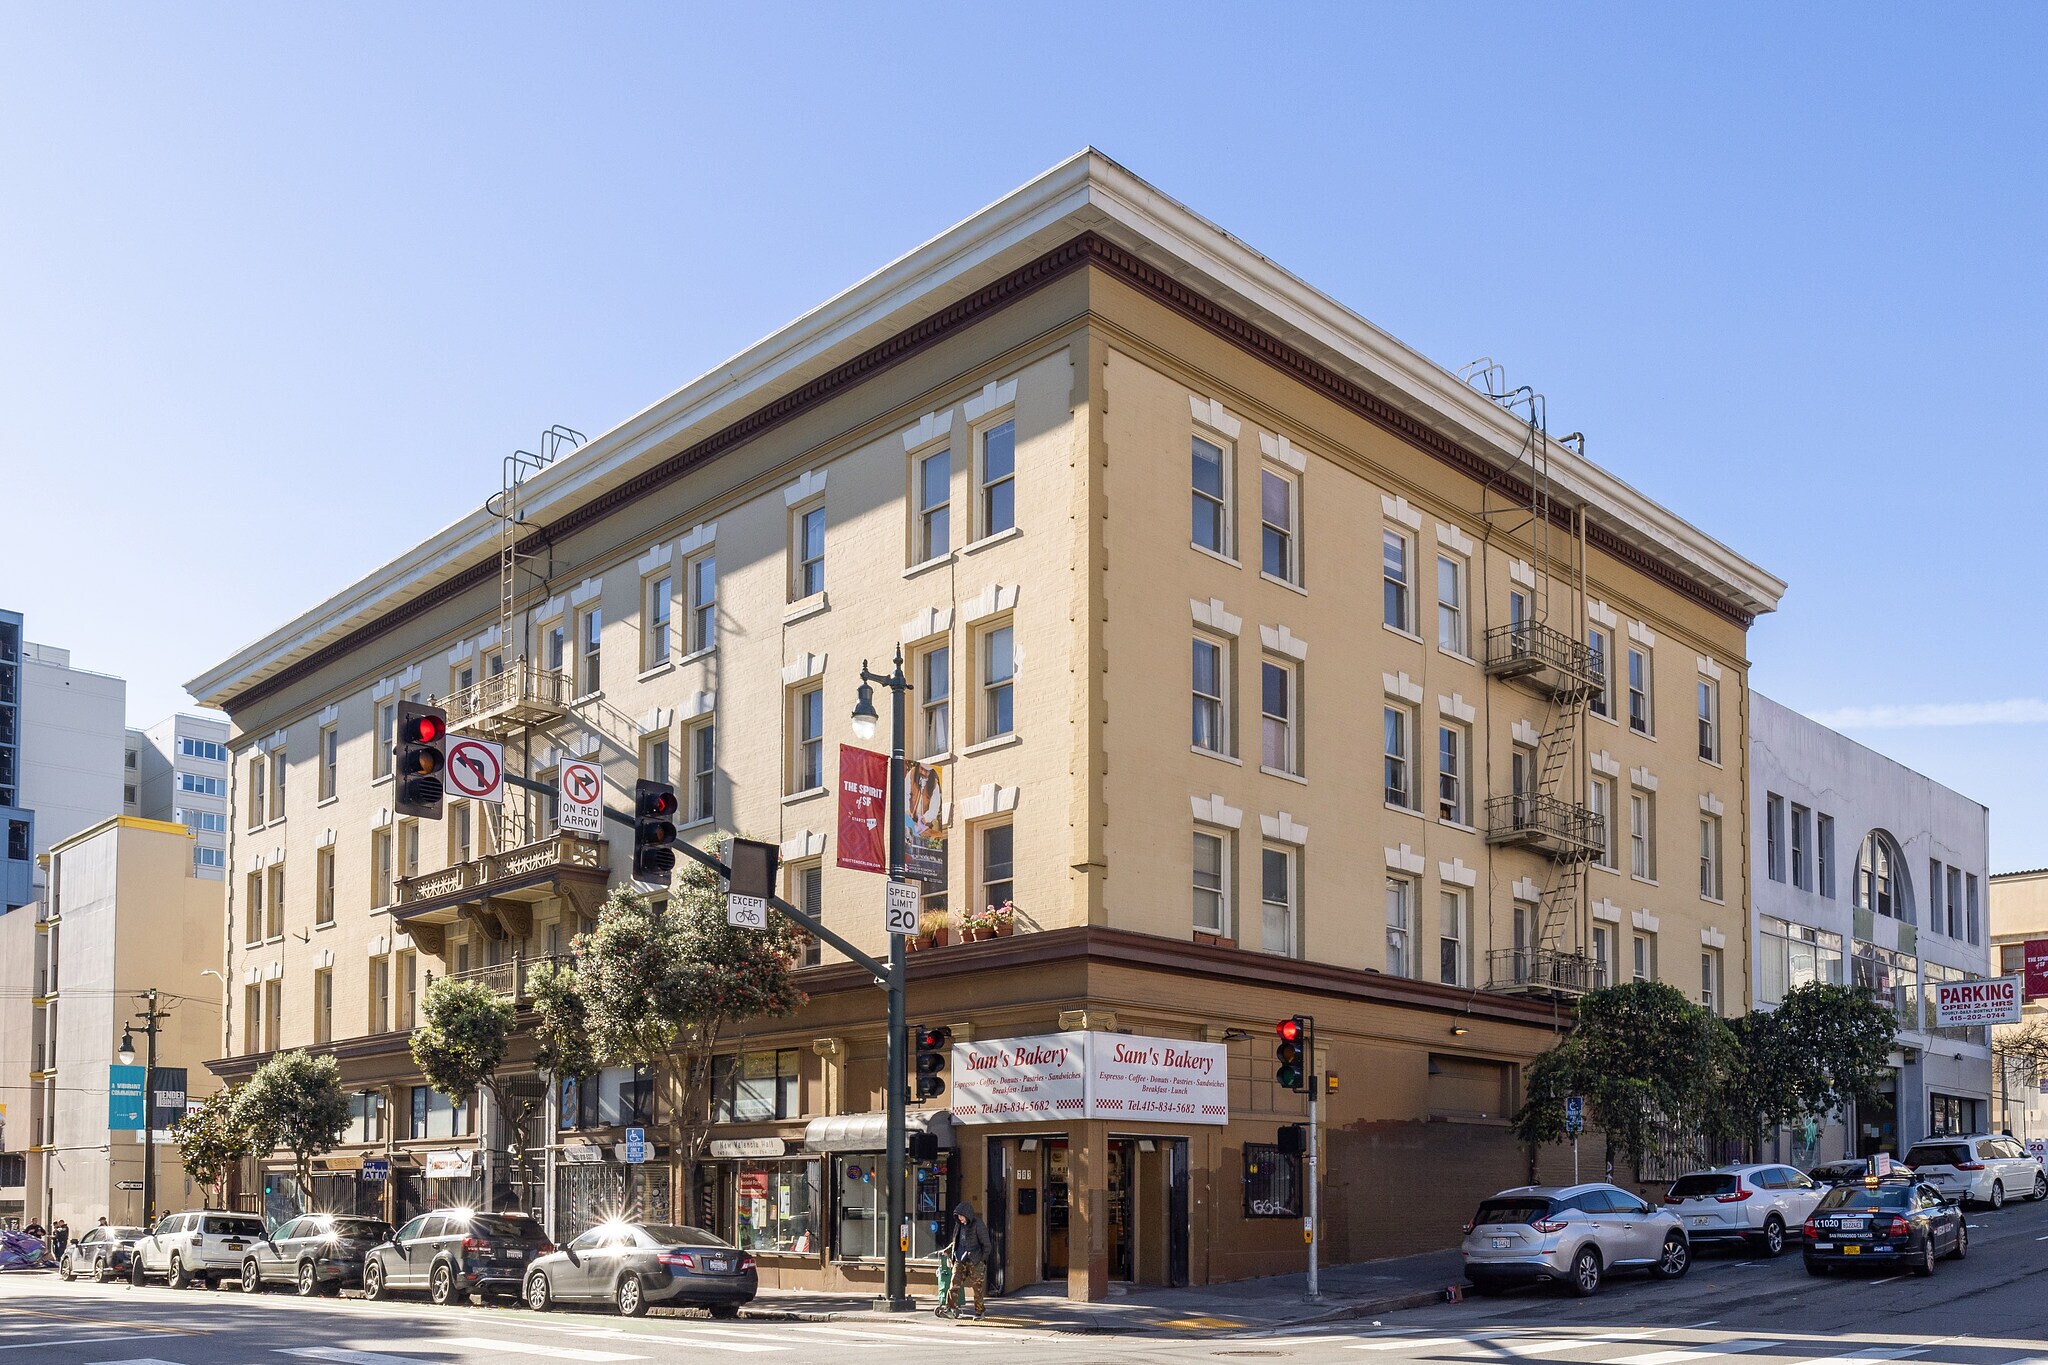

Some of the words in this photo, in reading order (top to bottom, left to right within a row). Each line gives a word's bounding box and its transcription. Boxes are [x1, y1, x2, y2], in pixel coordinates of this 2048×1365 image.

[843, 780, 858, 793] THE
[858, 784, 884, 799] SPIRIT
[862, 796, 872, 807] SF
[562, 803, 576, 814] ON
[580, 806, 600, 818] RED
[563, 814, 598, 828] ARROW
[889, 887, 917, 899] SPEED
[732, 895, 763, 908] EXCEPT
[891, 899, 913, 909] LIMIT
[889, 909, 915, 929] 20
[1940, 983, 2014, 1005] PARKING
[1949, 1012, 2006, 1021] 415-202-0744
[966, 1049, 1010, 1071] Sam's
[1013, 1045, 1069, 1067] Bakery
[1113, 1043, 1160, 1066] Sam's
[1163, 1048, 1214, 1075] Bakery
[954, 1081, 976, 1089] Espresso
[979, 1078, 996, 1087] Coffee
[1000, 1076, 1019, 1084] Donuts
[1023, 1074, 1044, 1082] Pastries
[1047, 1071, 1081, 1080] Sandwiches
[1099, 1072, 1124, 1080] Espresso
[1128, 1073, 1146, 1083] Coffee
[1150, 1075, 1169, 1083] Donuts
[1172, 1077, 1193, 1085] Pastries
[1195, 1079, 1225, 1087] Sandwiches
[992, 1086, 1017, 1095] Breakfast
[1020, 1084, 1039, 1093] Lunch
[1141, 1085, 1167, 1094] Breakfast
[981, 1100, 1050, 1114] Tel.415-834-5682
[1127, 1099, 1196, 1114] Tel.415-834-5682
[733, 1140, 759, 1149] Valencia
[761, 1140, 774, 1148] Hall
[364, 1171, 387, 1179] ATM
